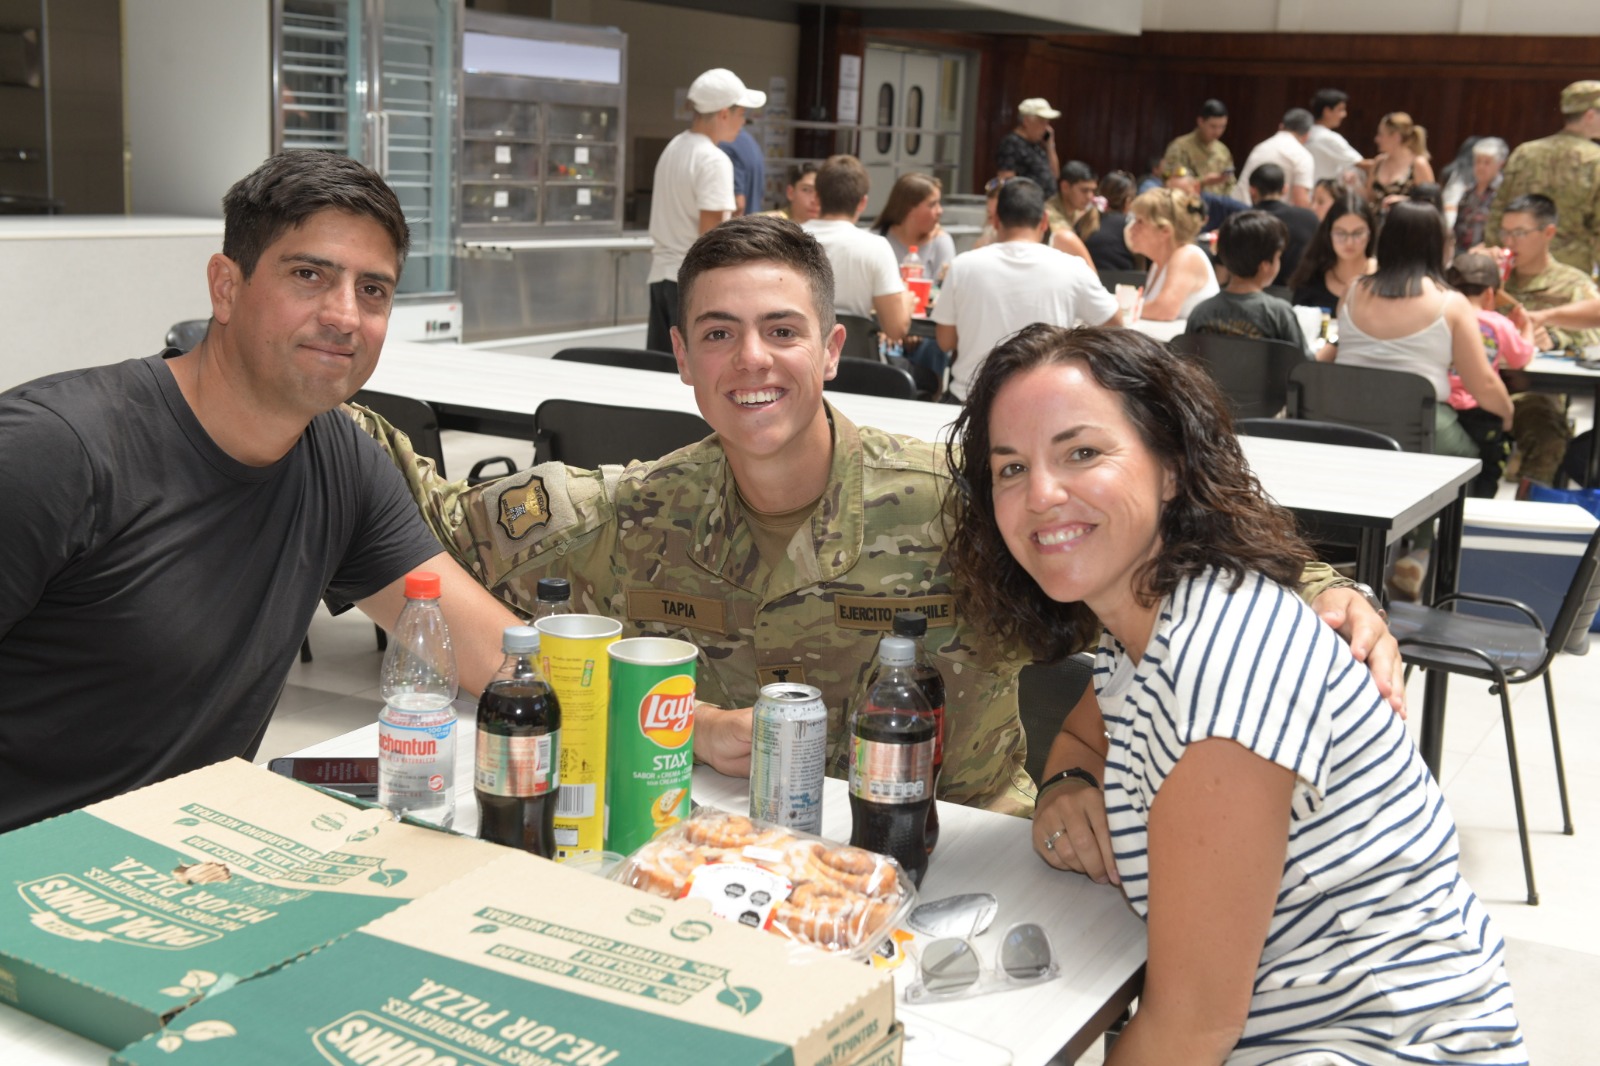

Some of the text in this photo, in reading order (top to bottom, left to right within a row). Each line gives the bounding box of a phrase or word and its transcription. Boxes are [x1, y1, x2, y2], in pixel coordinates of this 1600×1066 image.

[661, 600, 696, 619] TAPIA
[840, 604, 892, 622] EJERCITO
[652, 751, 687, 771] STAX
[184, 804, 239, 831] NEUTRAL
[186, 836, 253, 873] RECICLADO
[175, 906, 246, 932] MEJORES
[181, 889, 279, 925] MEJOR
[482, 907, 546, 934] NEUTRAL
[107, 915, 208, 947] PAPA
[489, 944, 573, 976] RECICLADO
[572, 966, 649, 994] MATERIAL
[499, 1016, 620, 1066] MEJOR
